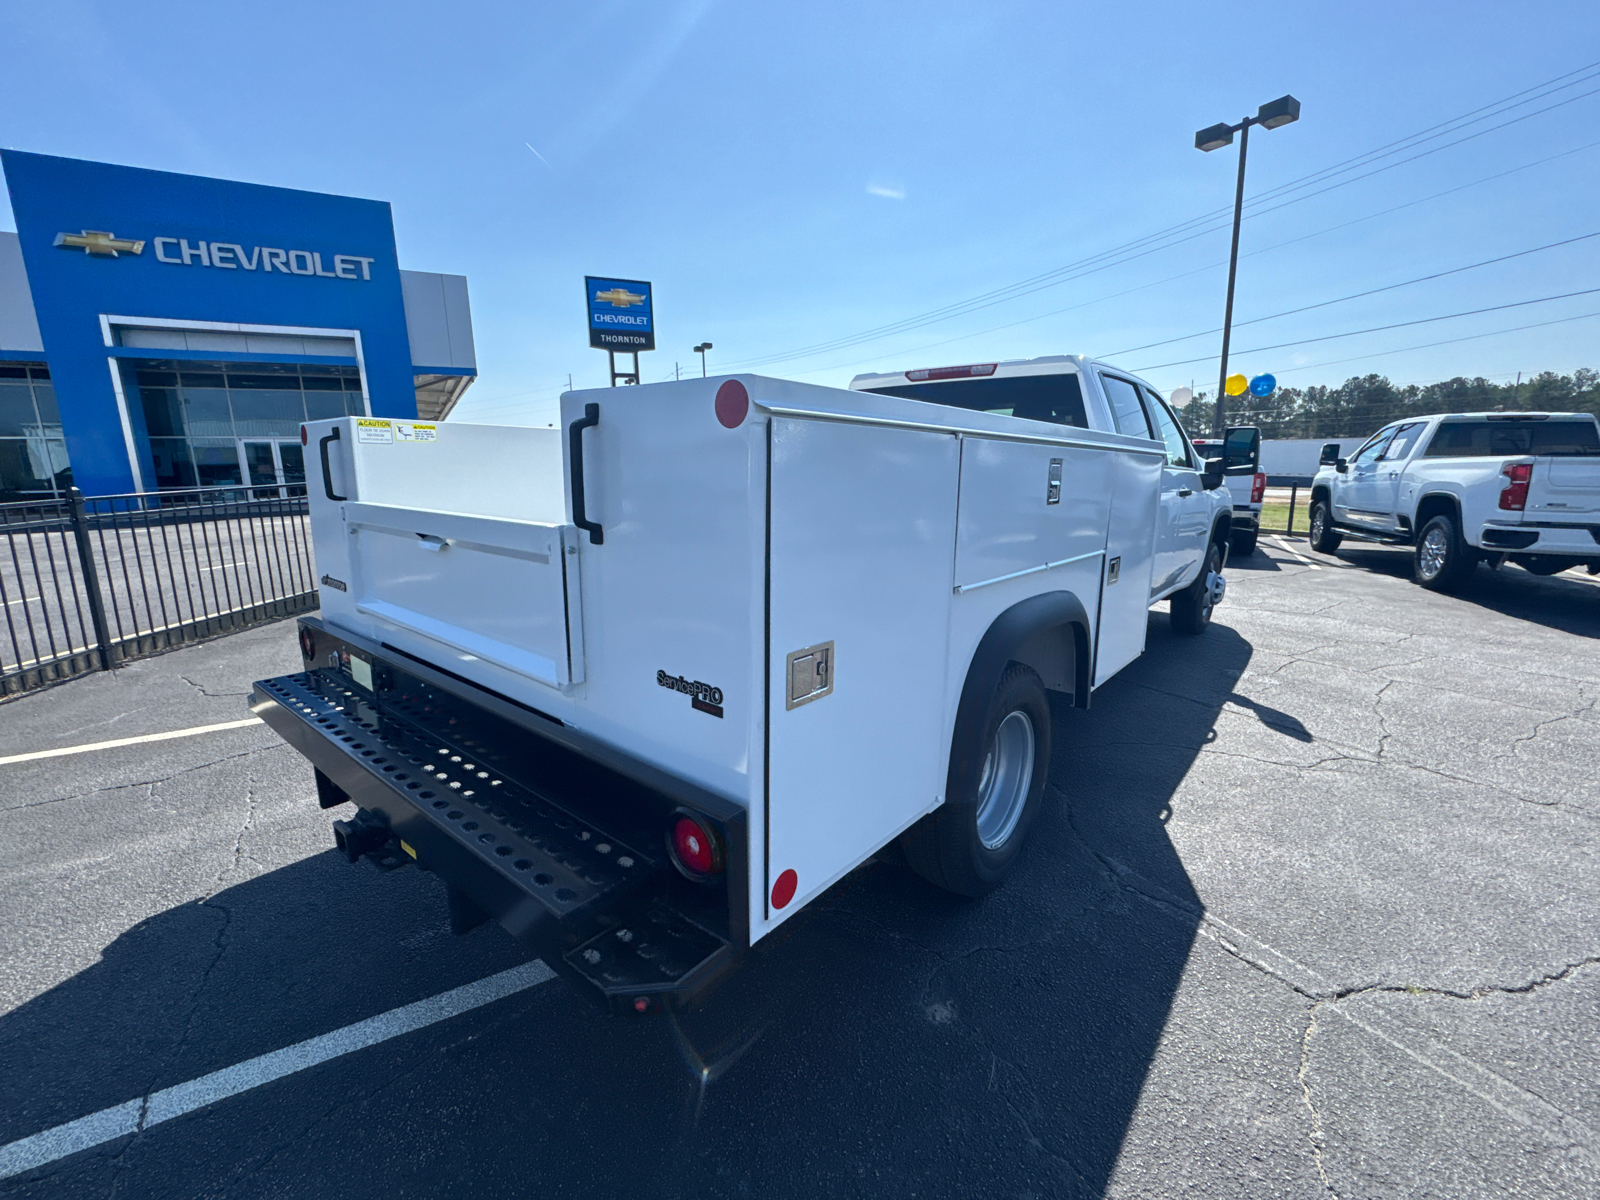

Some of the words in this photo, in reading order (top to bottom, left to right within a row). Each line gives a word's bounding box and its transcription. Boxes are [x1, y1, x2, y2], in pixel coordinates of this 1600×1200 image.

[153, 236, 375, 281] CHEVROLET
[594, 313, 648, 325] CHEVROLET
[600, 334, 646, 344] THORNTON
[657, 669, 723, 705] ServicePRO
